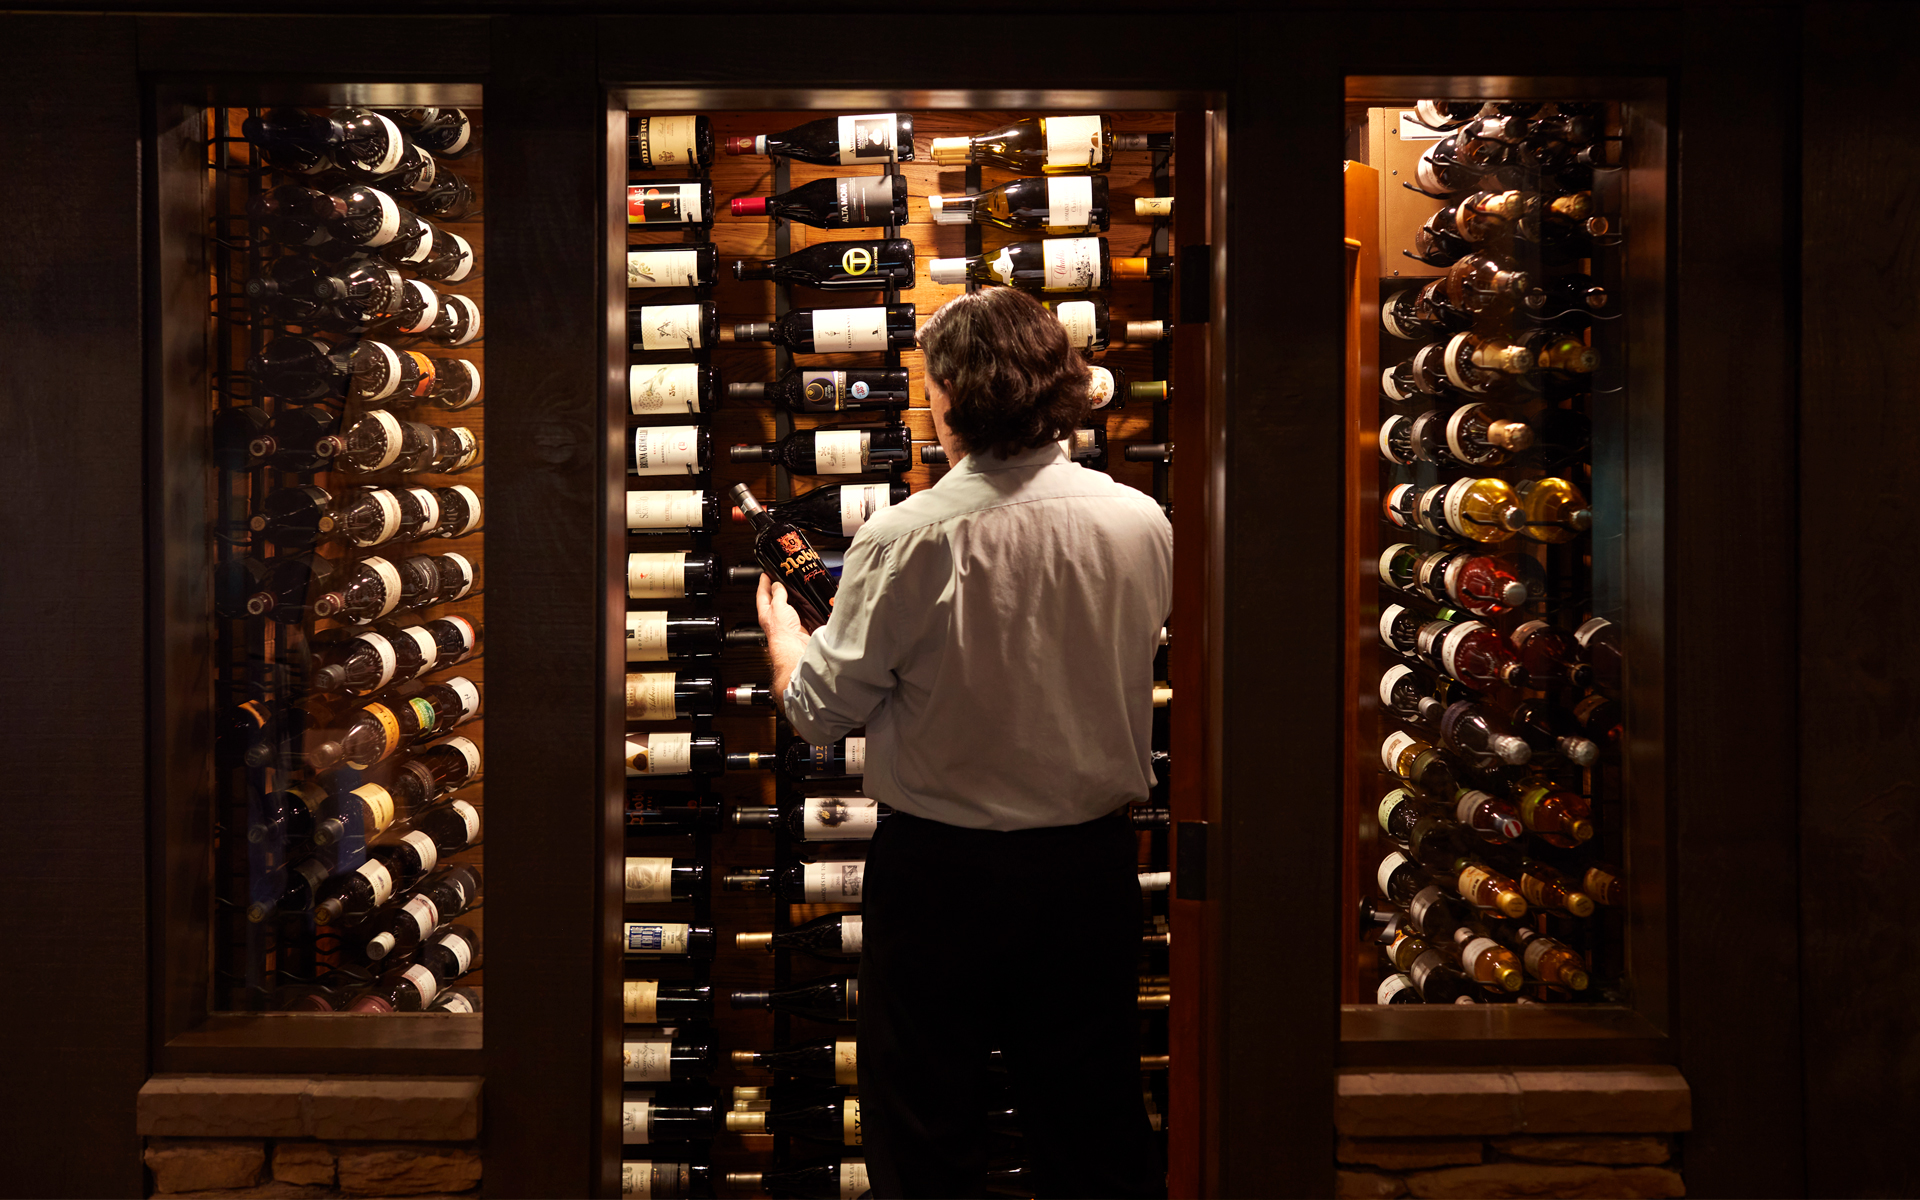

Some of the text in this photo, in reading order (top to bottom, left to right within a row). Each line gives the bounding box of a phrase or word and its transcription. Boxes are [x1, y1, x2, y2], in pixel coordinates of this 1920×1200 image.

[640, 118, 650, 164] ODDERO
[634, 189, 646, 206] ABE
[840, 183, 850, 223] ALTA MORA
[638, 452, 650, 469] BRUNA
[801, 562, 818, 574] FIVE
